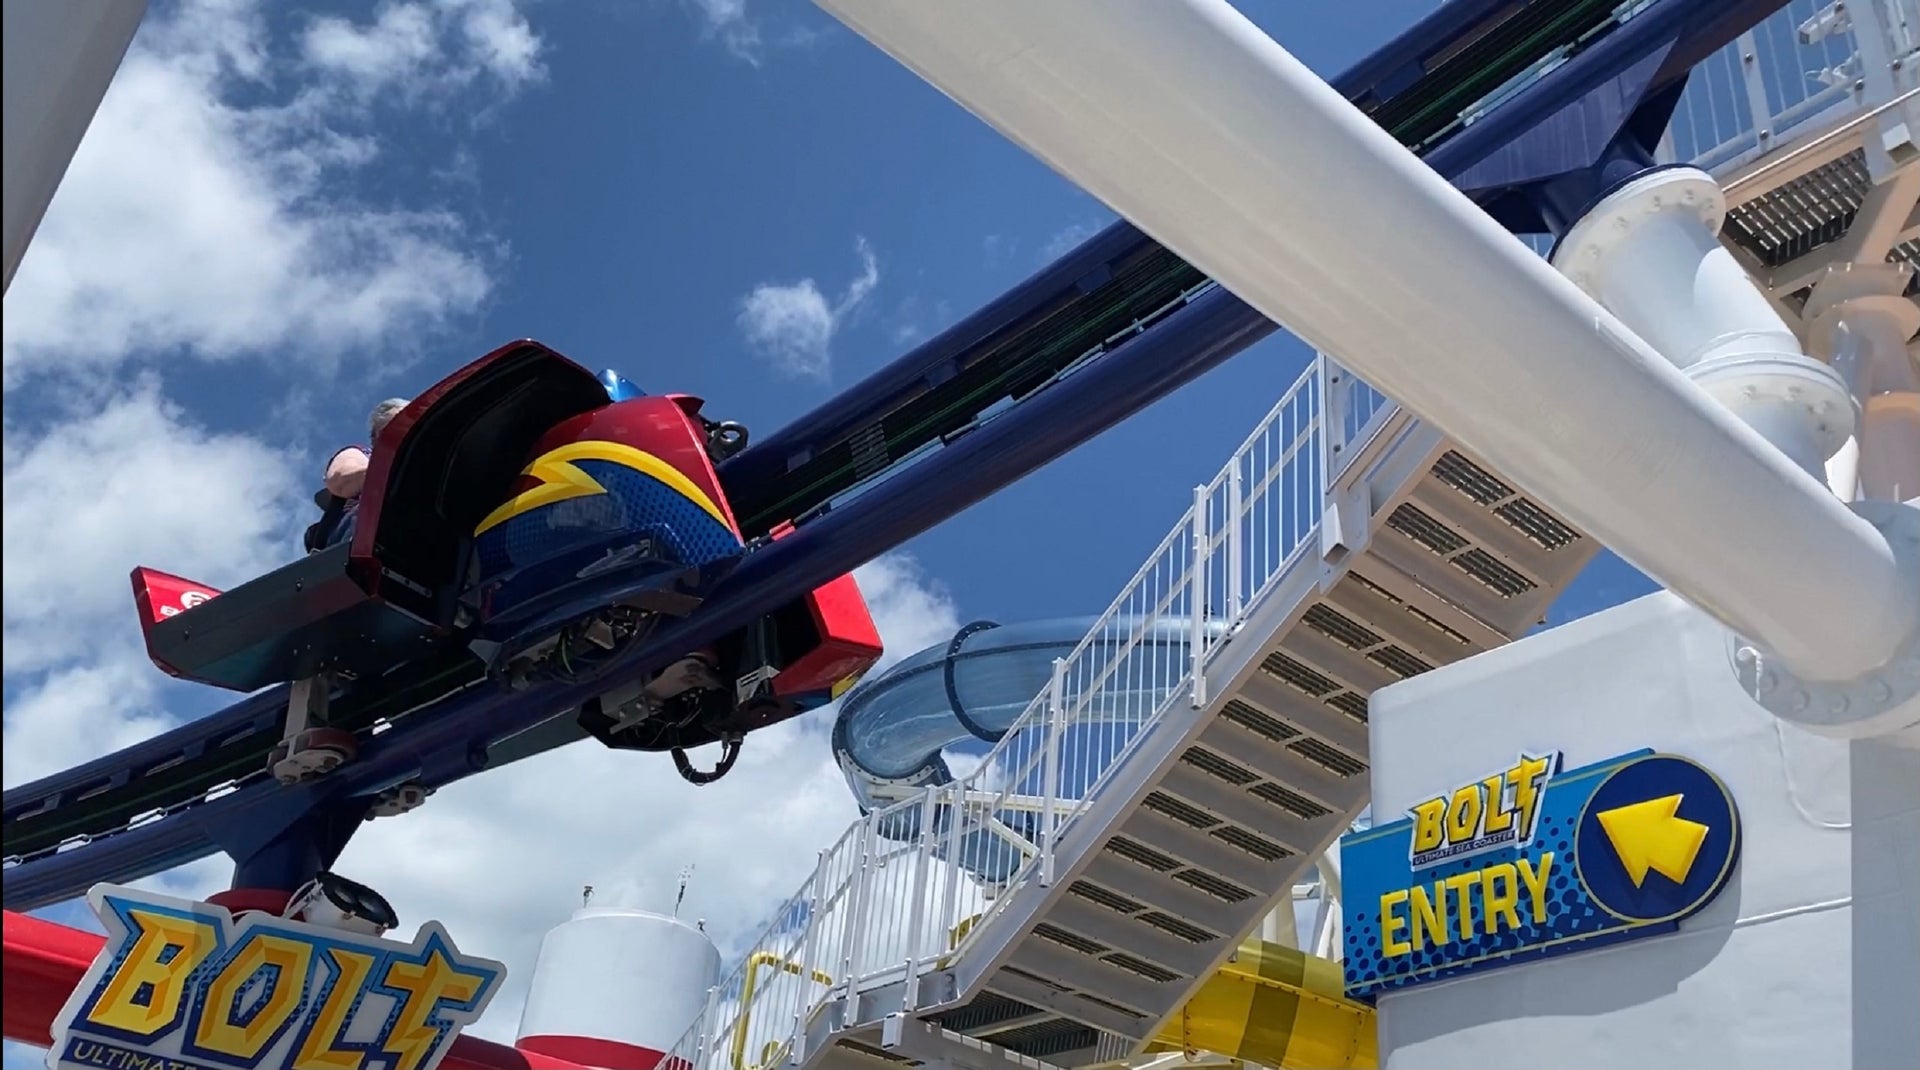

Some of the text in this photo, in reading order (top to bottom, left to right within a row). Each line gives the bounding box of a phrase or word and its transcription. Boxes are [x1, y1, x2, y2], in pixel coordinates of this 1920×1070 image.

[1414, 757, 1549, 853] BOLT
[1414, 832, 1514, 865] ULTIMATE SEA COASTER
[1380, 851, 1555, 957] ENTRY
[86, 908, 486, 1070] BOLT
[73, 1041, 198, 1070] ULTIMAT
